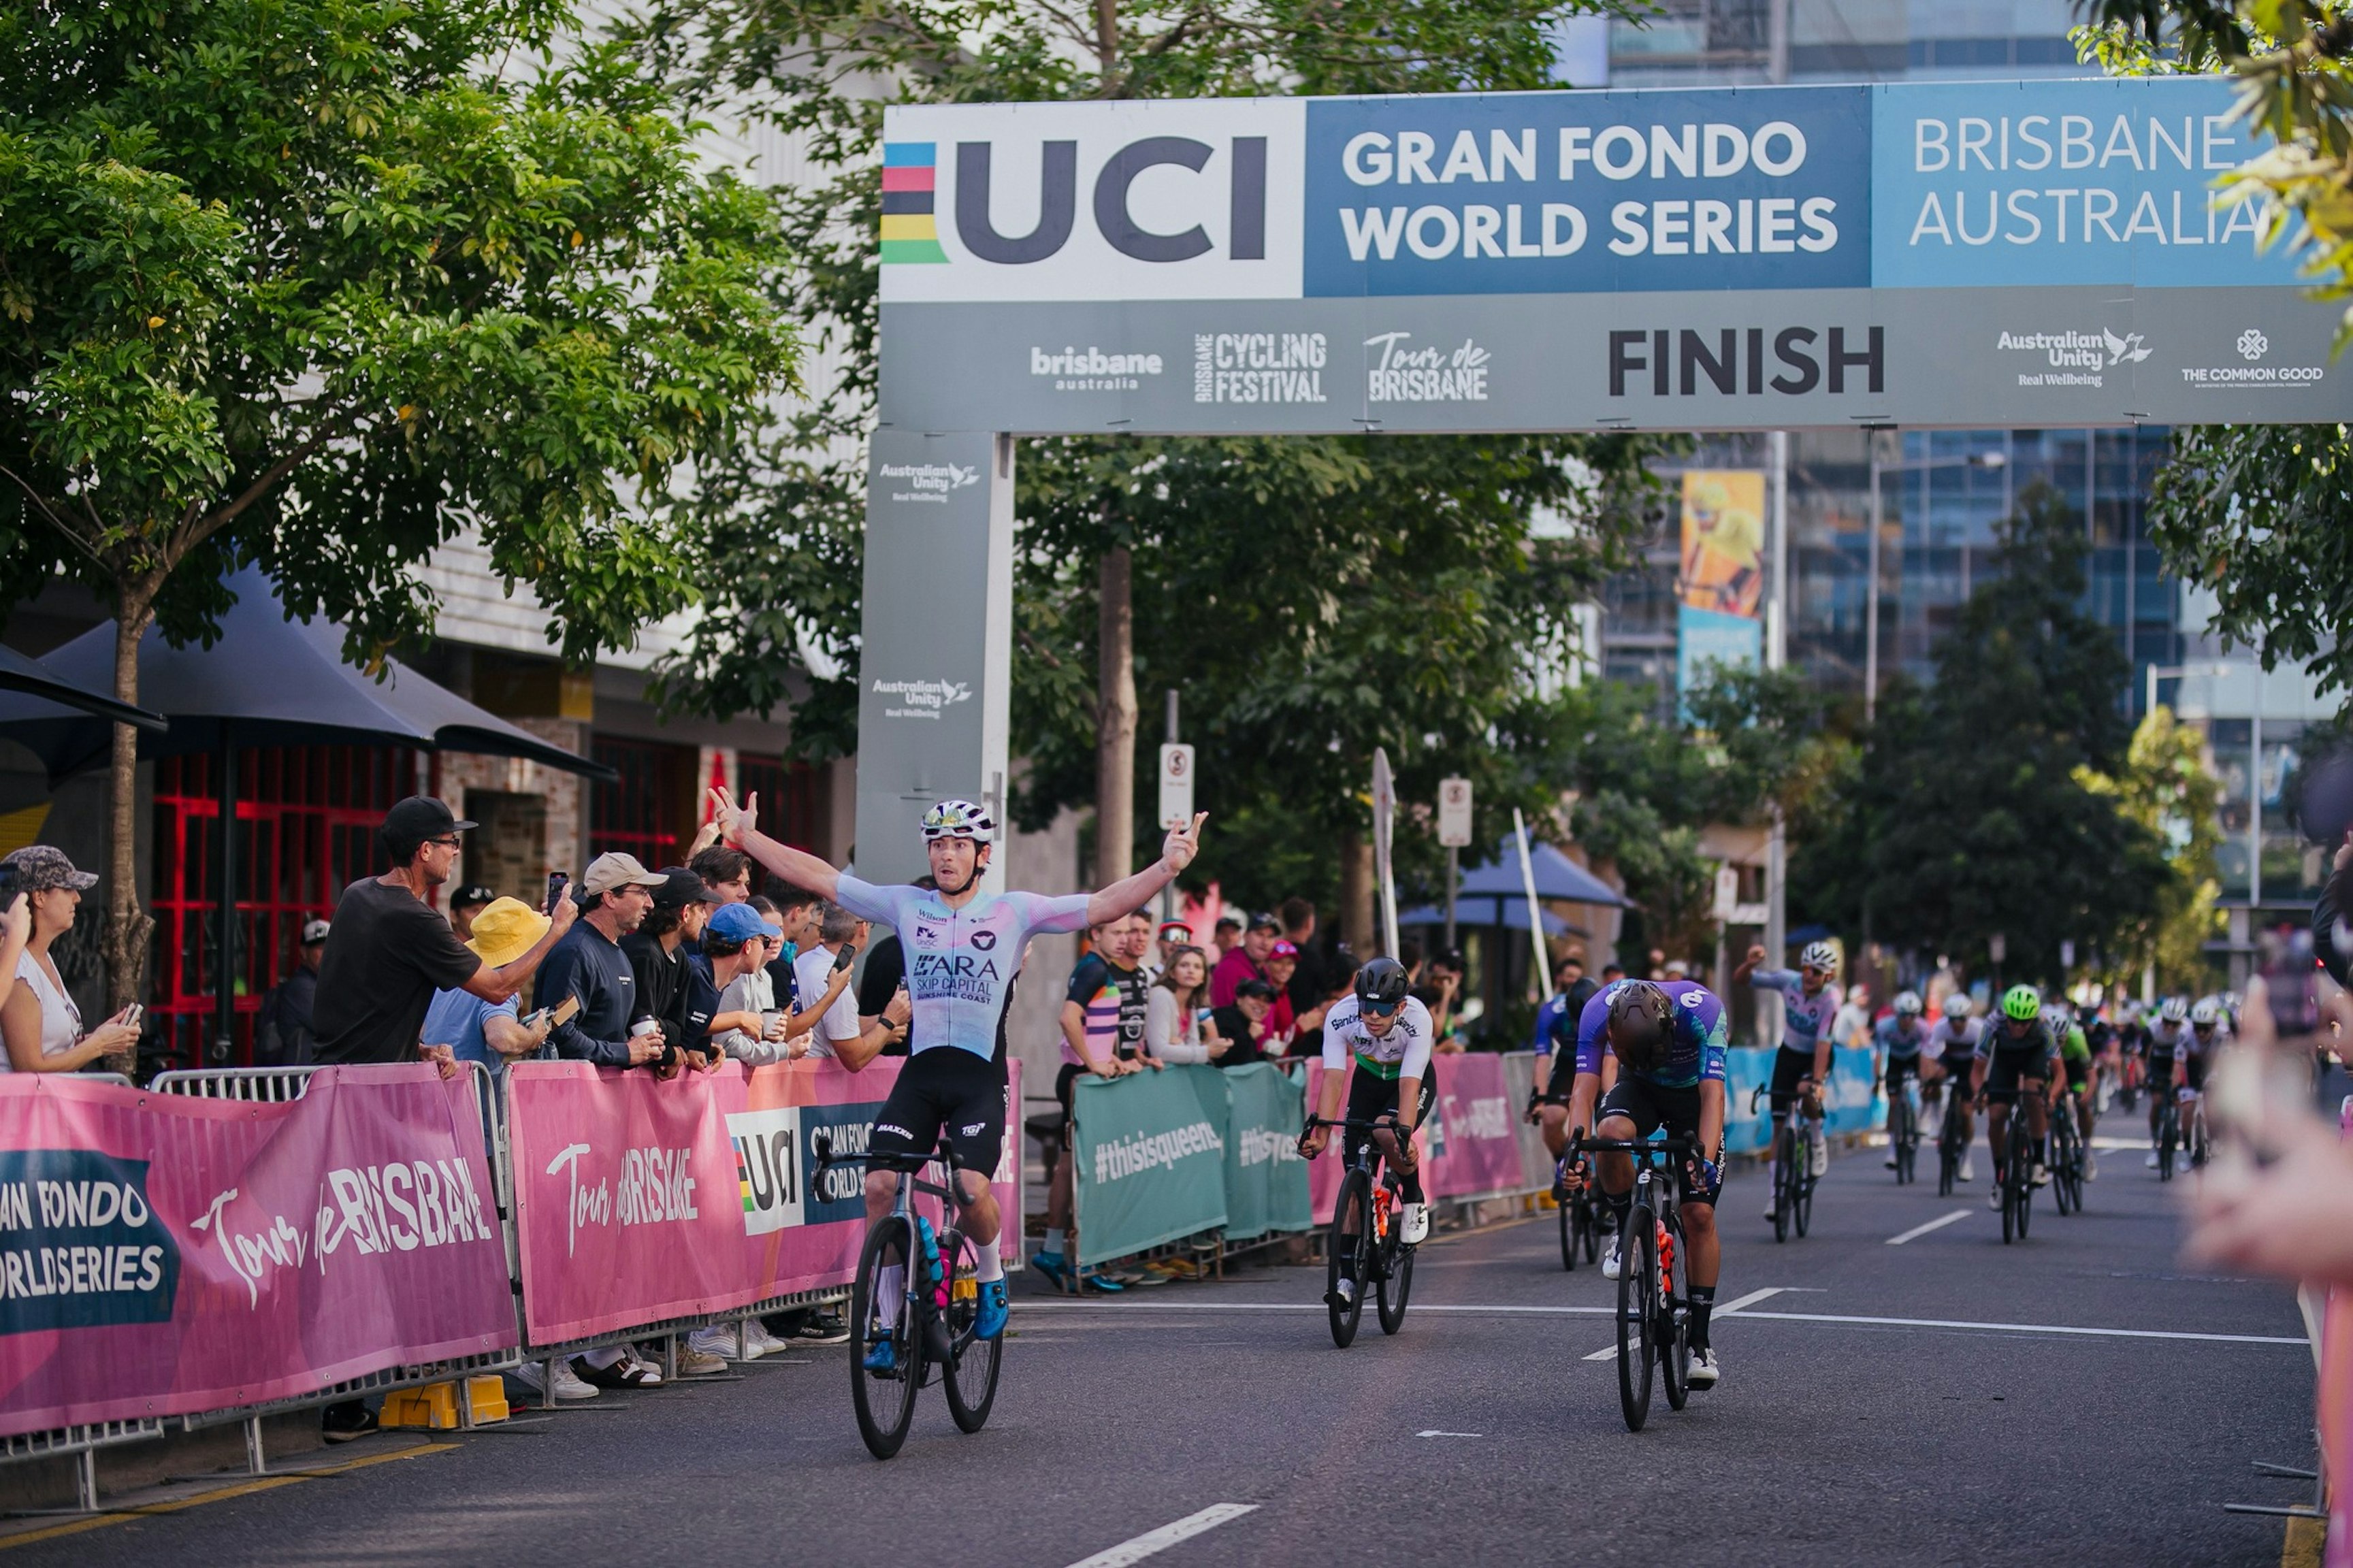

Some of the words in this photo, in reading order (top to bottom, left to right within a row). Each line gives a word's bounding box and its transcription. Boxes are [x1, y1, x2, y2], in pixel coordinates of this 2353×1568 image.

[1342, 128, 1537, 186] GRAN
[1559, 120, 1808, 181] FONDO
[955, 136, 1267, 265] UCI
[1339, 203, 1587, 261] WORLD
[1608, 196, 1839, 256] SERIES
[1909, 189, 2260, 246] AUSTRALIA
[1216, 333, 1327, 368] CYCLING
[1363, 331, 1446, 372] Tour
[1452, 338, 1491, 372] de
[1997, 331, 2104, 349] Australian
[1031, 346, 1163, 374] brisbane
[1195, 333, 1213, 403] BRISBANE
[1609, 325, 1884, 396] FINISH
[2049, 348, 2103, 371] Unity
[2182, 368, 2207, 380] THE
[2210, 368, 2275, 380] COMMON
[2279, 368, 2324, 380] GOOD
[1056, 378, 1138, 390] australia
[1216, 371, 1327, 402] FESTIVAL
[1369, 368, 1489, 402] BRISBANE
[2019, 374, 2043, 385] Real
[2045, 374, 2103, 388] Wellbeing
[879, 463, 949, 476] Australian
[913, 476, 948, 492] Unity
[873, 679, 941, 692] Australian
[905, 692, 941, 708] Unity
[919, 909, 947, 923] Wilson
[917, 978, 939, 991] SKIP
[942, 978, 991, 996] CAPITAL
[918, 992, 958, 1000] SUNSHINE
[960, 993, 991, 1004] COAST
[877, 1124, 913, 1141] MAXXIS
[811, 1166, 858, 1202] ORLD
[37, 1181, 148, 1228] FONDO
[546, 1143, 611, 1259] Tour
[190, 1188, 308, 1311] Tour
